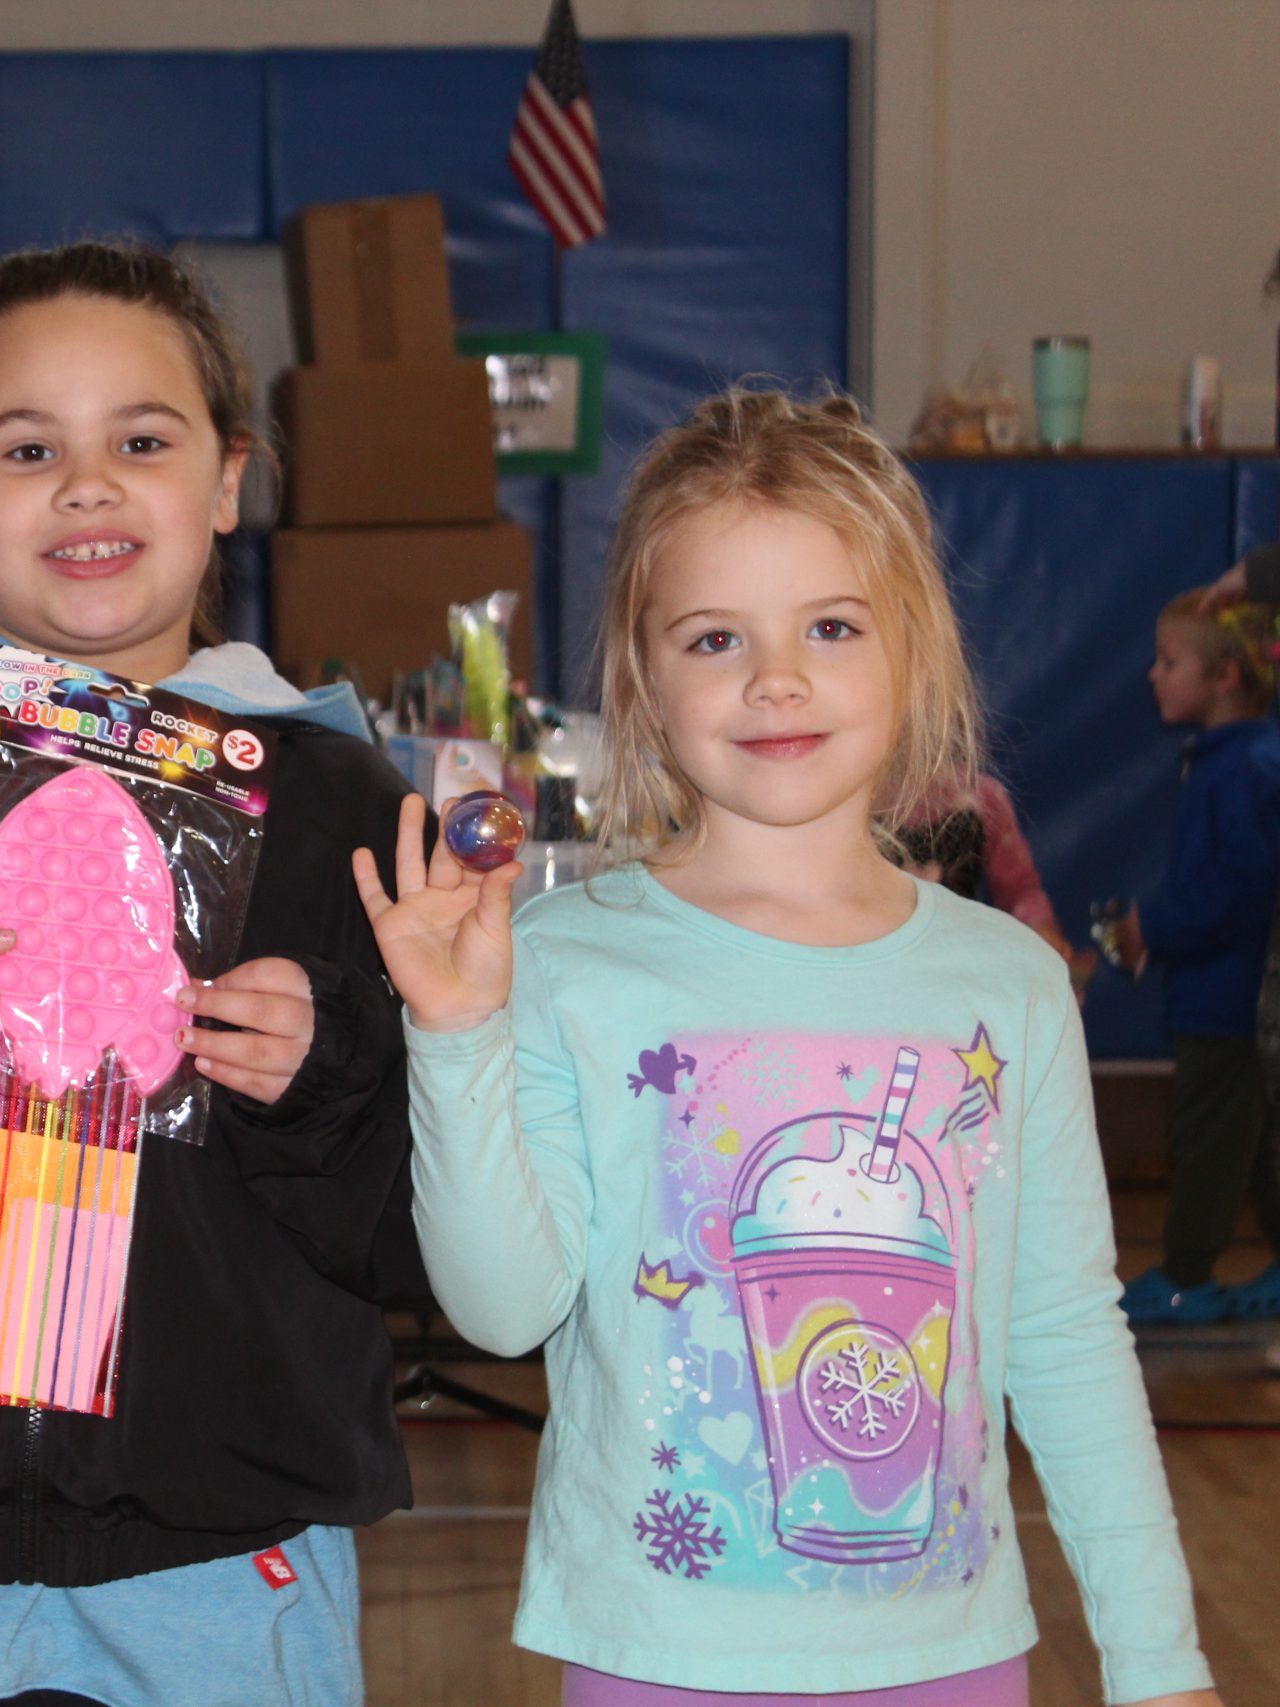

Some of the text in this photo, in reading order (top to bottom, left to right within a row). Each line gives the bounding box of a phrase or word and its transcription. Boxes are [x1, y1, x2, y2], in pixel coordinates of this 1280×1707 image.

[24, 663, 36, 674] IN
[39, 665, 60, 677] THE
[19, 699, 215, 771] BUBBLE SNAP
[151, 711, 218, 743] ROCKET
[50, 734, 160, 770] HELPS RELIEVE STRESS
[227, 735, 257, 766] $2
